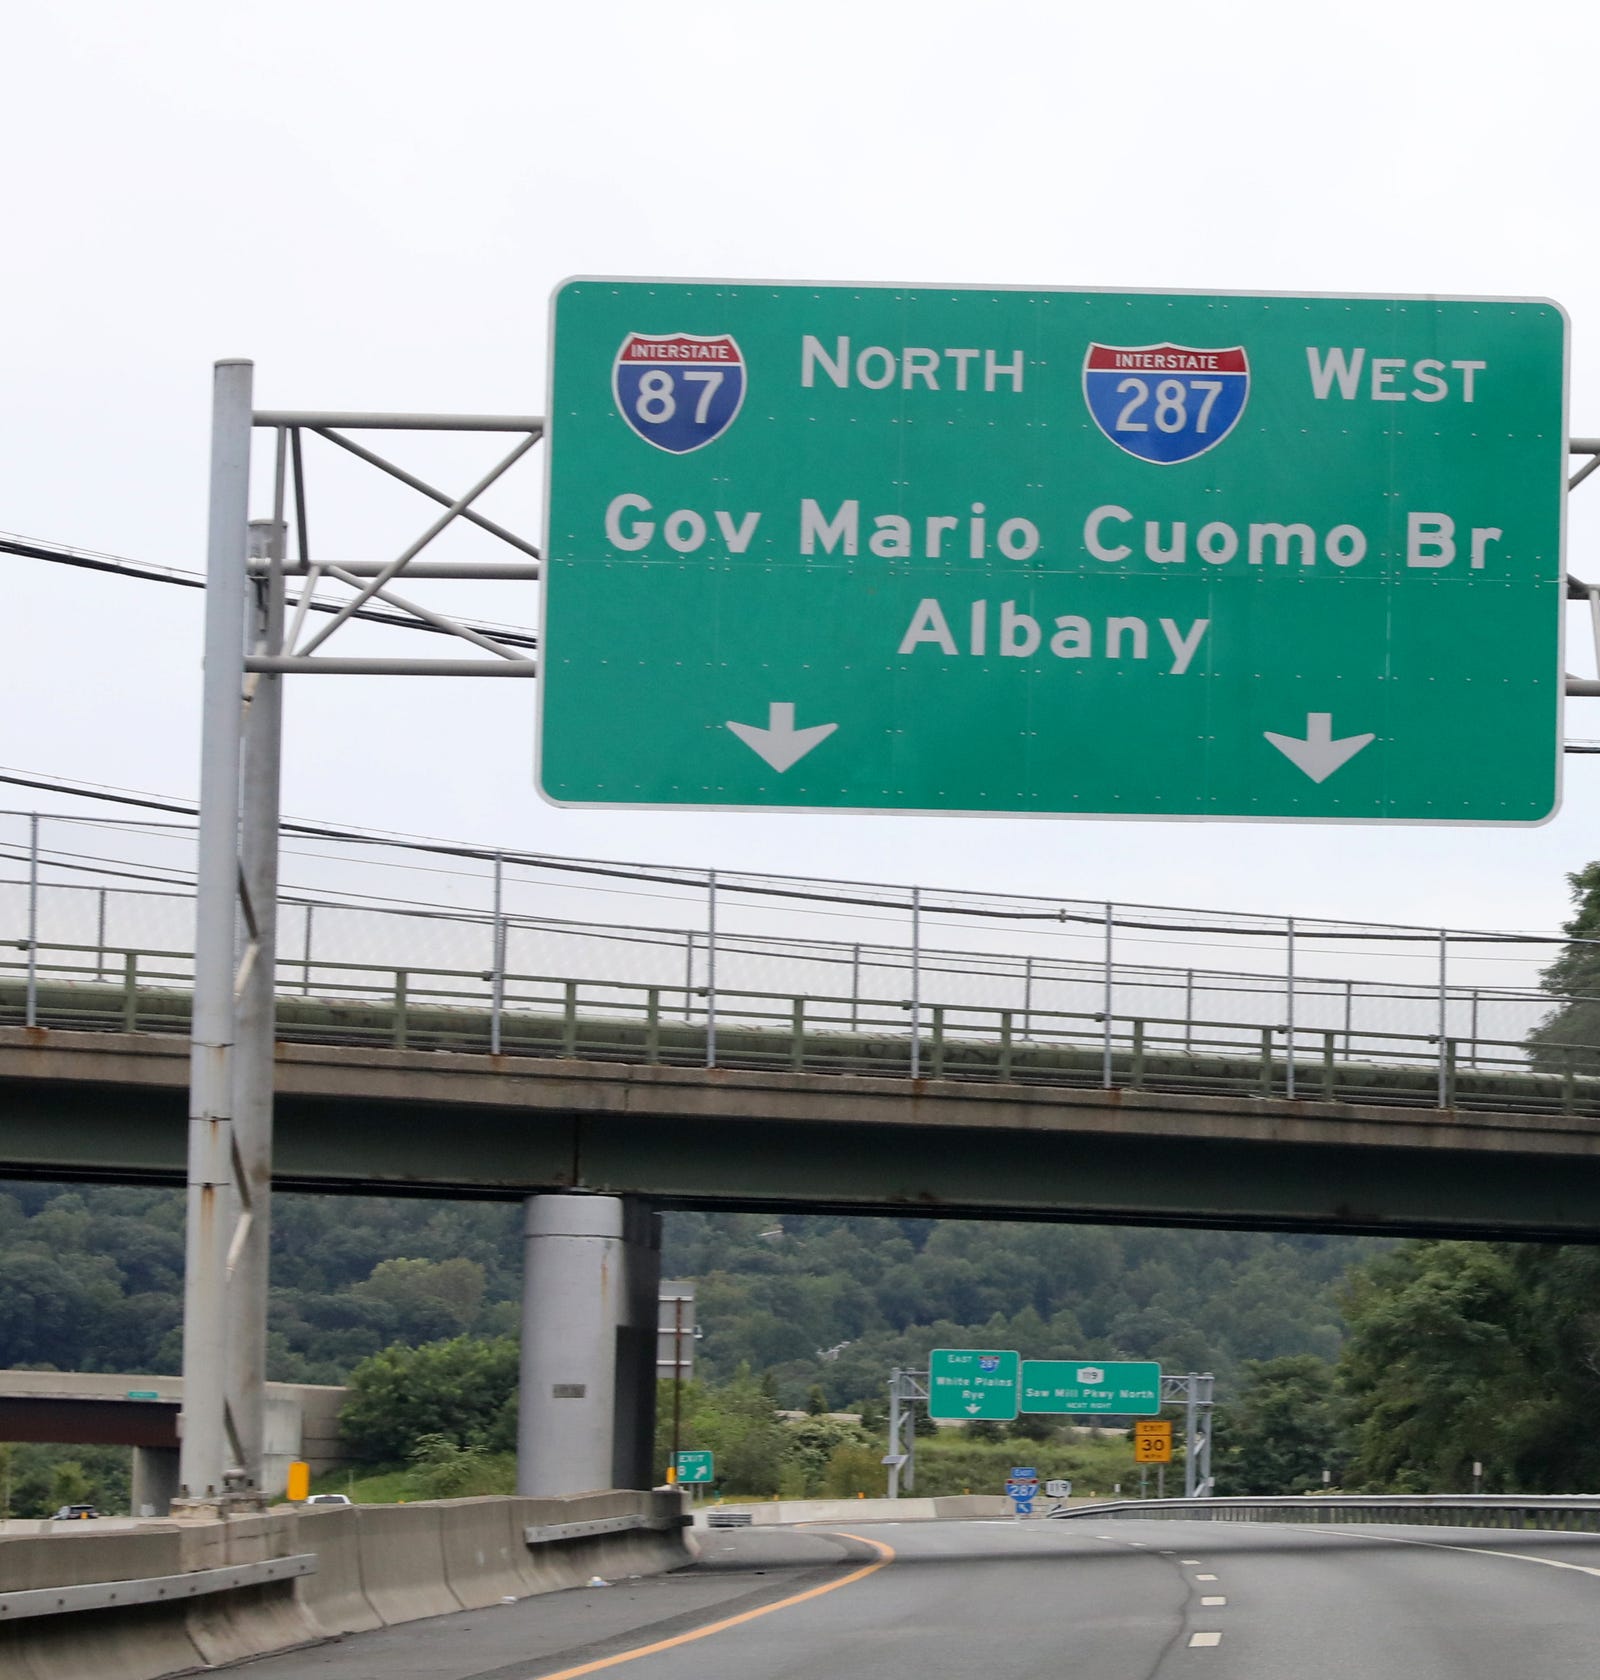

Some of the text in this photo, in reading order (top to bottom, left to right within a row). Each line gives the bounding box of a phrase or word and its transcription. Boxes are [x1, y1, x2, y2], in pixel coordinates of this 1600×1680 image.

[631, 344, 730, 360] INTERSTATE
[801, 335, 1024, 393] NORTH
[1115, 353, 1218, 370] INTERSTATE
[1306, 346, 1487, 403] WEST
[635, 369, 724, 424] 87
[1115, 377, 1223, 434] 287
[605, 493, 1503, 569] Gov Mario Cuomo Br
[898, 598, 1210, 675] Albany
[980, 1359, 1000, 1368] 287
[936, 1376, 1013, 1387] White Plains
[962, 1390, 985, 1400] Rye
[1025, 1388, 1155, 1399] Saw Mill Pkwy North
[1142, 1439, 1164, 1451] 30
[1010, 1485, 1036, 1496] 287
[1050, 1483, 1068, 1492] 119
